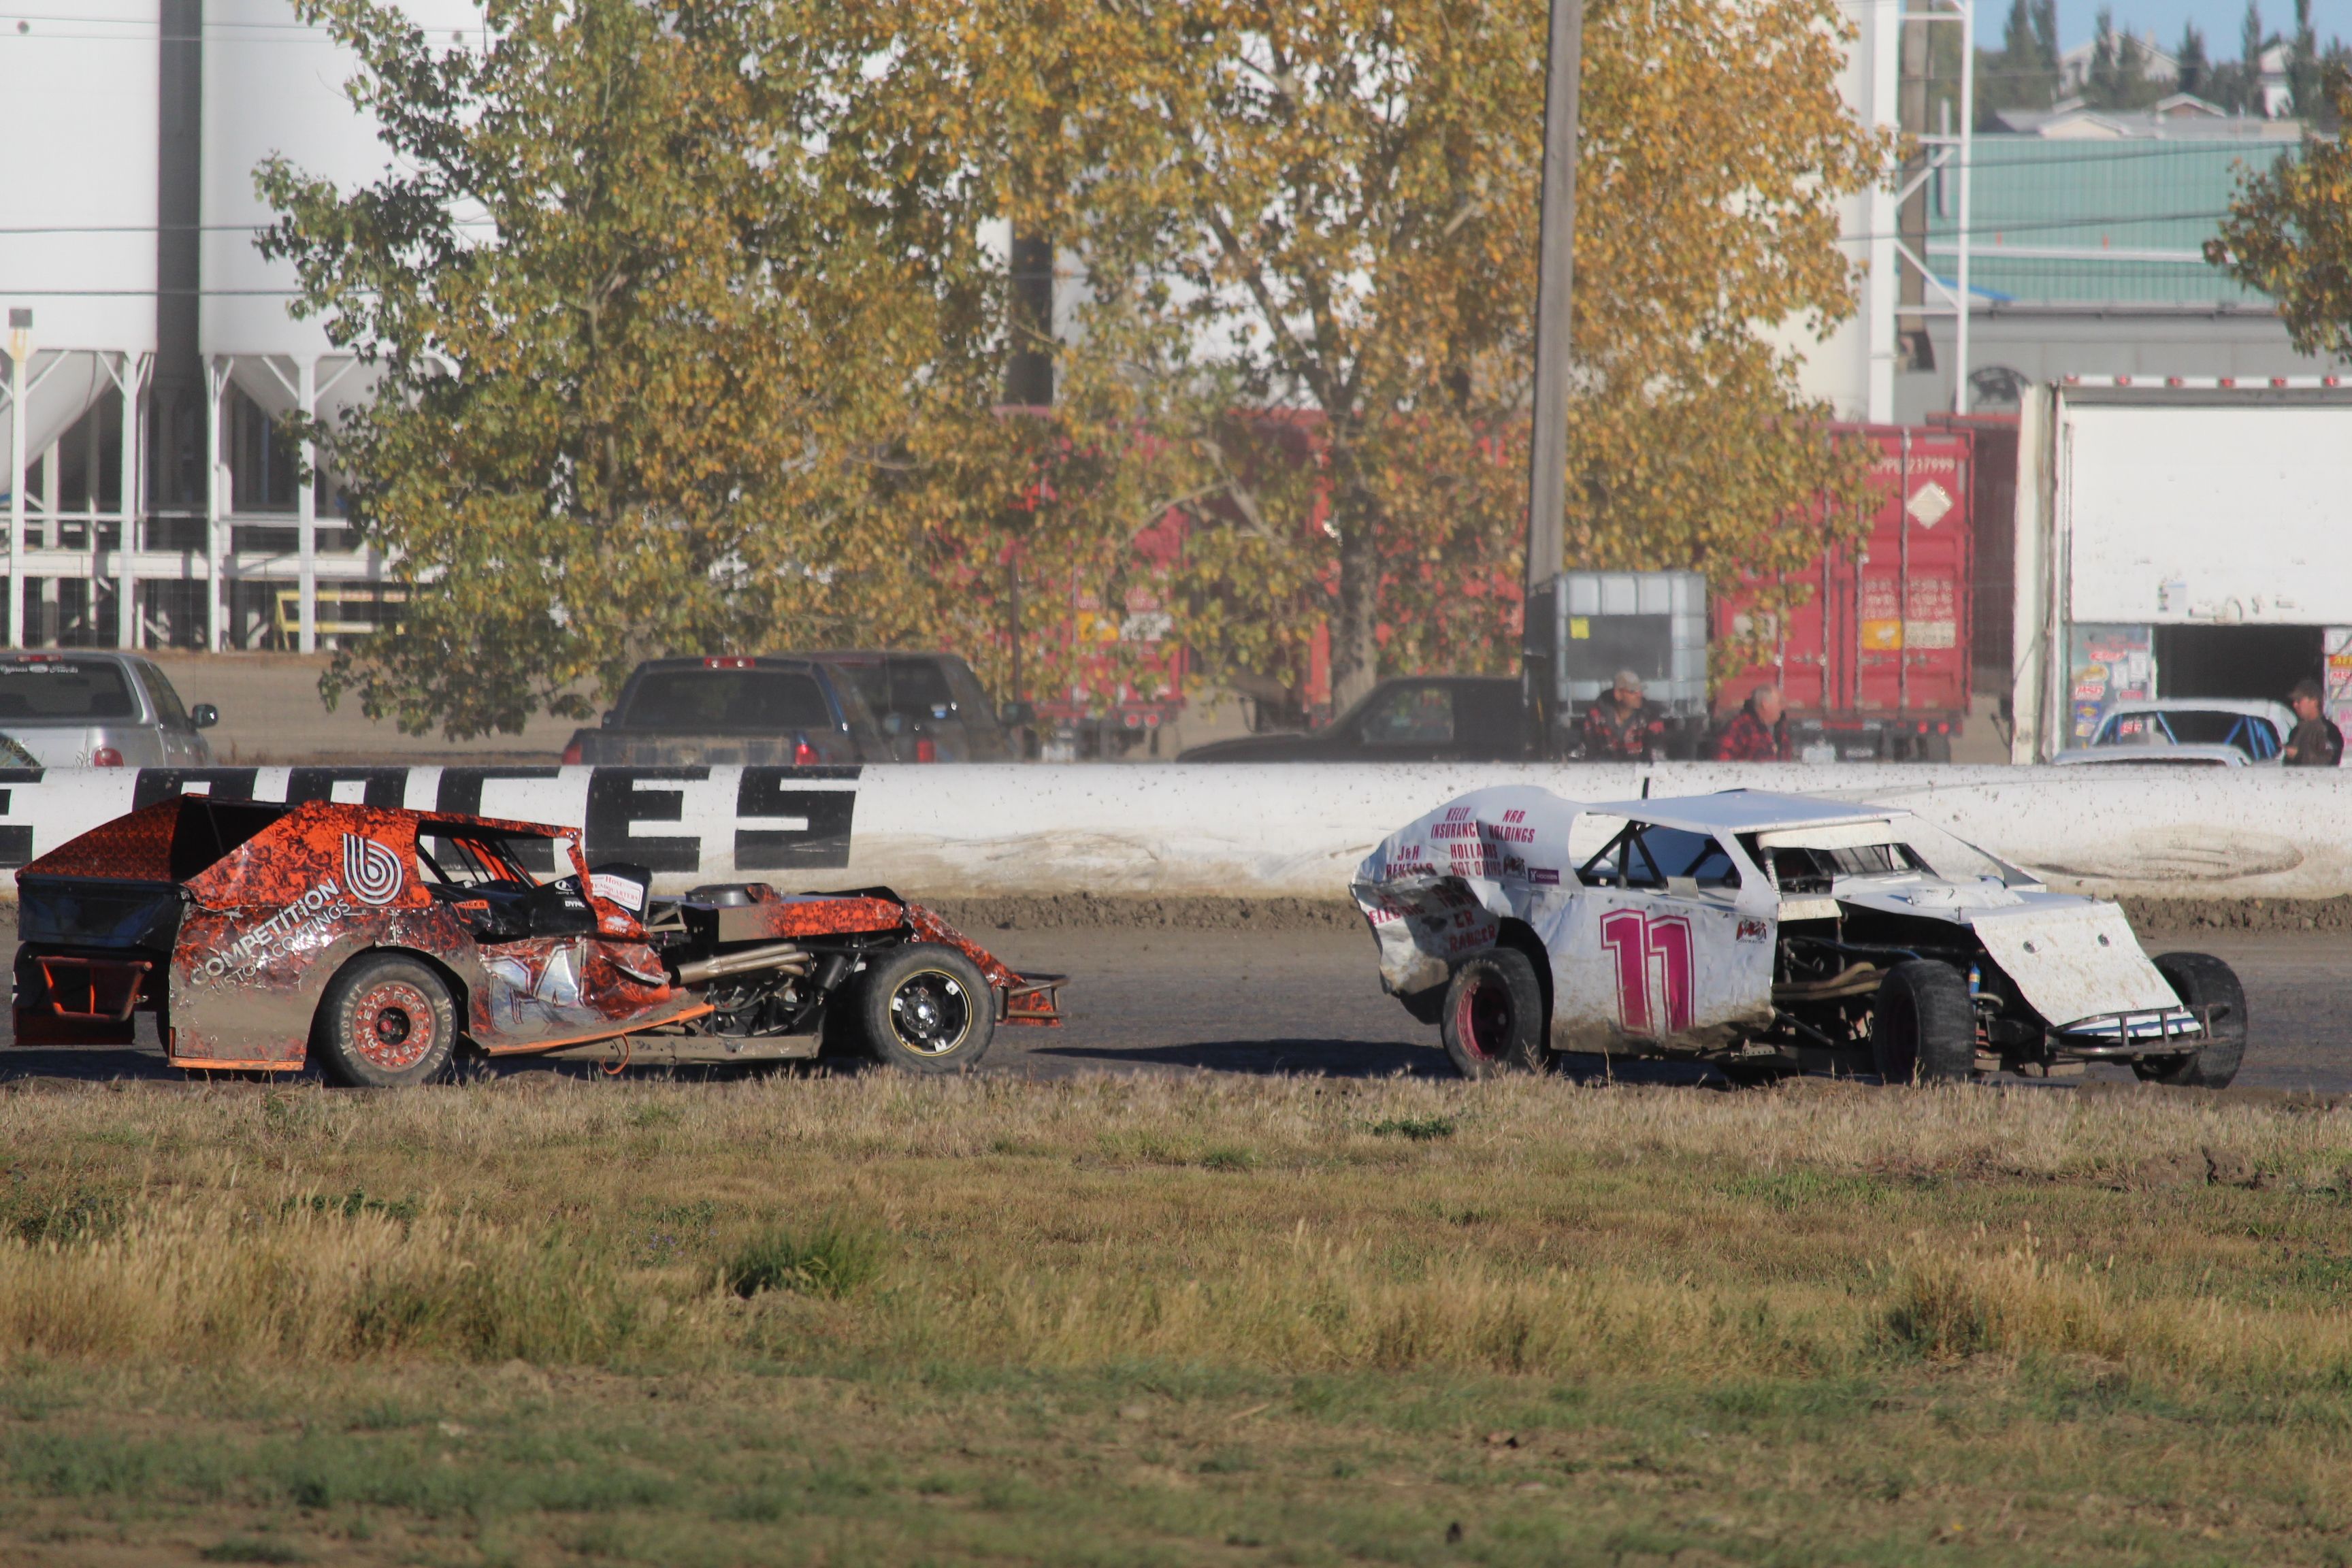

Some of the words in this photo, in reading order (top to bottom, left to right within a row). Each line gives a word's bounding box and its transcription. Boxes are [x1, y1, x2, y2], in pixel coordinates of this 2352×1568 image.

[1445, 807, 1471, 821] KELLY
[1502, 810, 1526, 824] NRB
[1431, 822, 1482, 840] INSURANCE
[1488, 824, 1536, 844] HOLDINGS
[1397, 845, 1420, 862] J&H
[1450, 860, 1471, 878] HOT
[191, 878, 340, 985] COMPETITION
[272, 898, 350, 958] COATINGS
[606, 924, 627, 934] CRATE
[1600, 909, 1695, 1037] 11
[363, 992, 387, 1021] EYE
